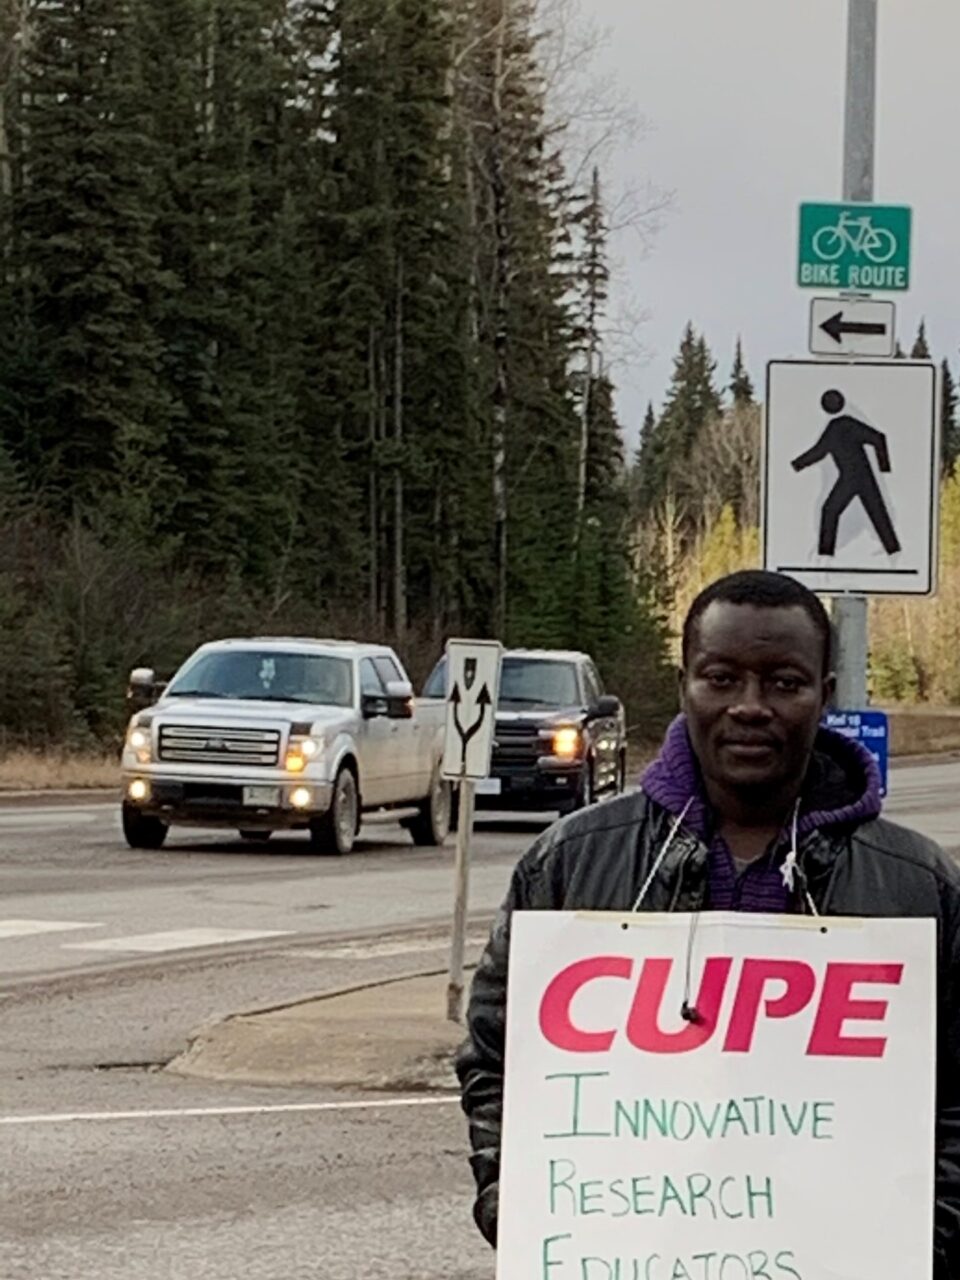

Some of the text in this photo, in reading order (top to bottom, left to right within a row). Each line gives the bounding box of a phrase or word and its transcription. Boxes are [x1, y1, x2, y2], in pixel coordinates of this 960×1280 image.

[800, 264, 906, 287] BIKE ROUTE
[538, 956, 905, 1057] CUPE
[543, 1071, 835, 1140] INNOVATIVE
[548, 1159, 775, 1219] RESEARCH
